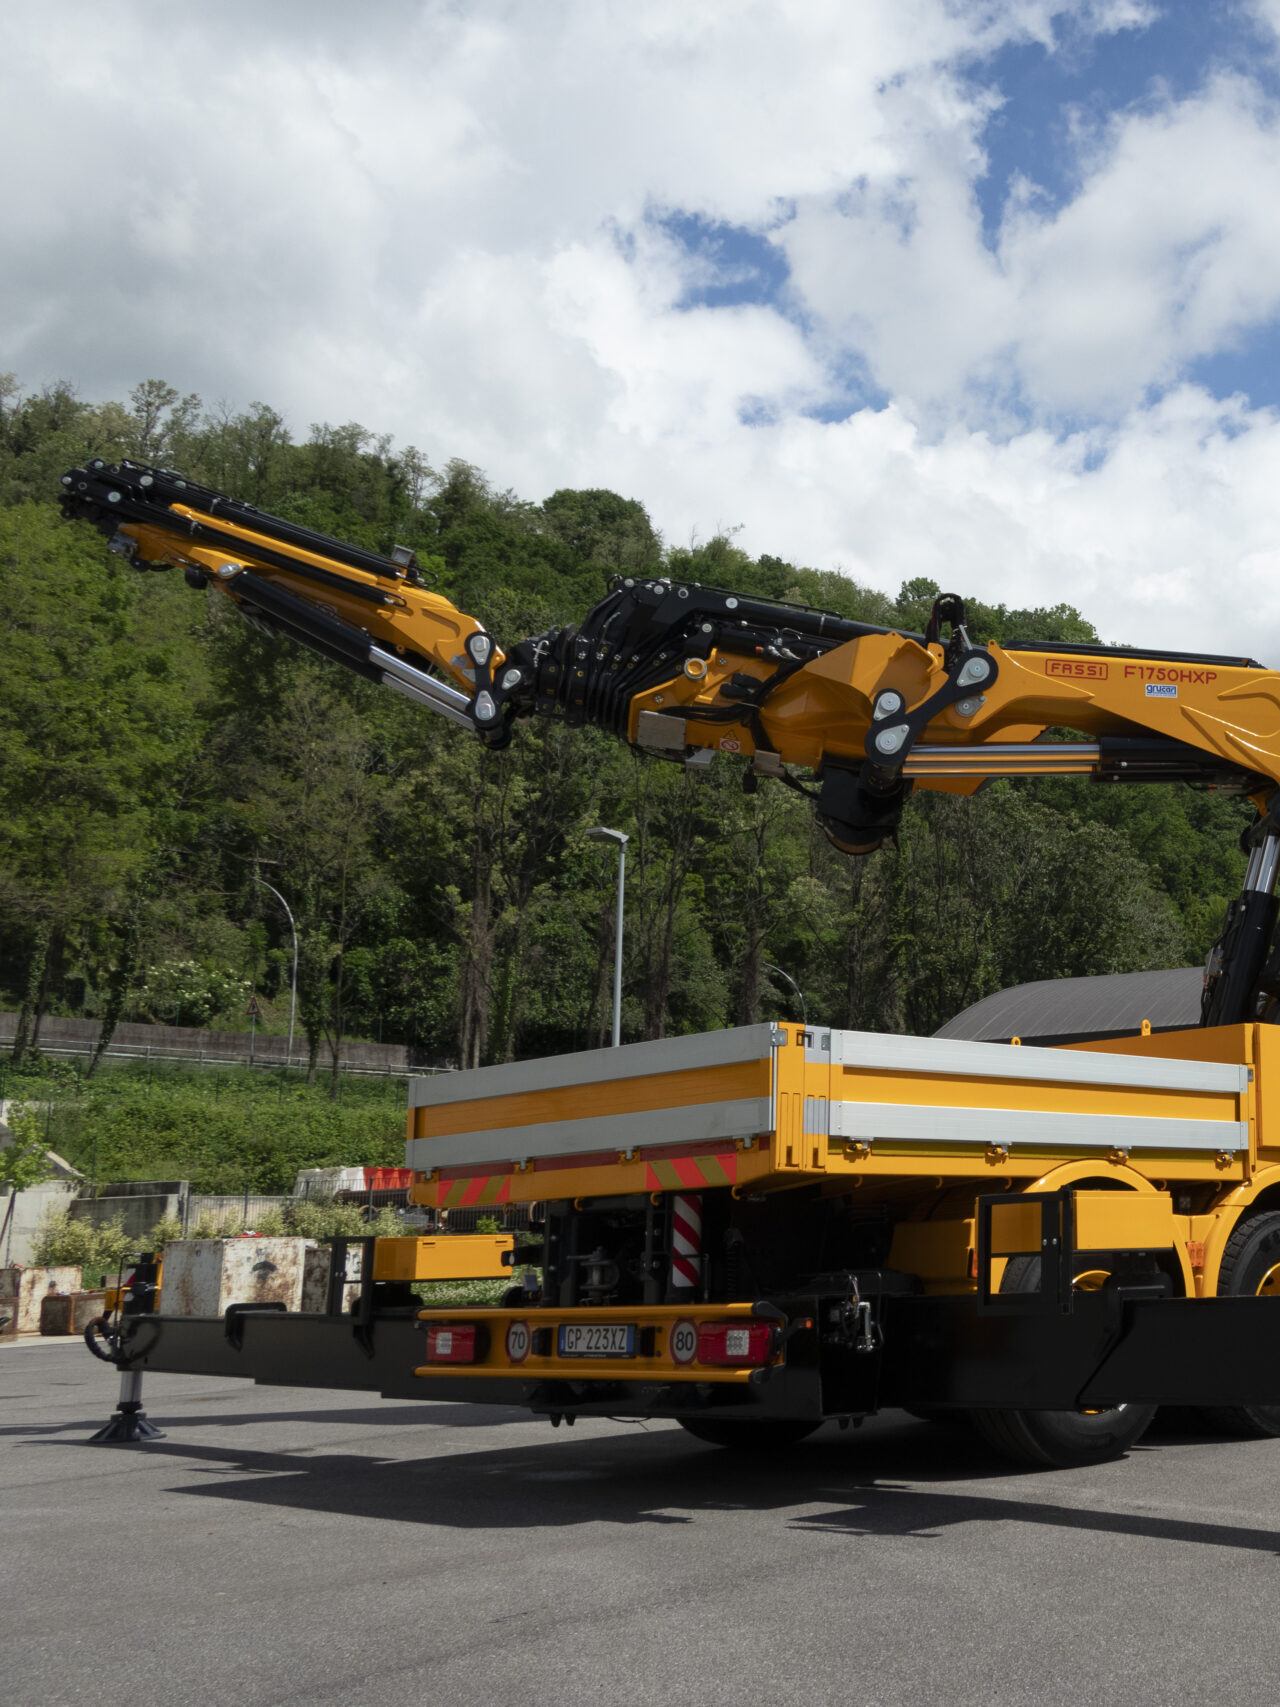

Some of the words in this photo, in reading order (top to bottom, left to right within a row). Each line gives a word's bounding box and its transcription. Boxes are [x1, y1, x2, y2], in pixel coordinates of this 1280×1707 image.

[1051, 662, 1103, 677] FASSI
[1124, 665, 1217, 684] F1750HXP
[511, 1331, 526, 1350] 70
[567, 1328, 582, 1350] GP
[586, 1327, 626, 1350] 223XZ
[676, 1331, 694, 1351] 80
